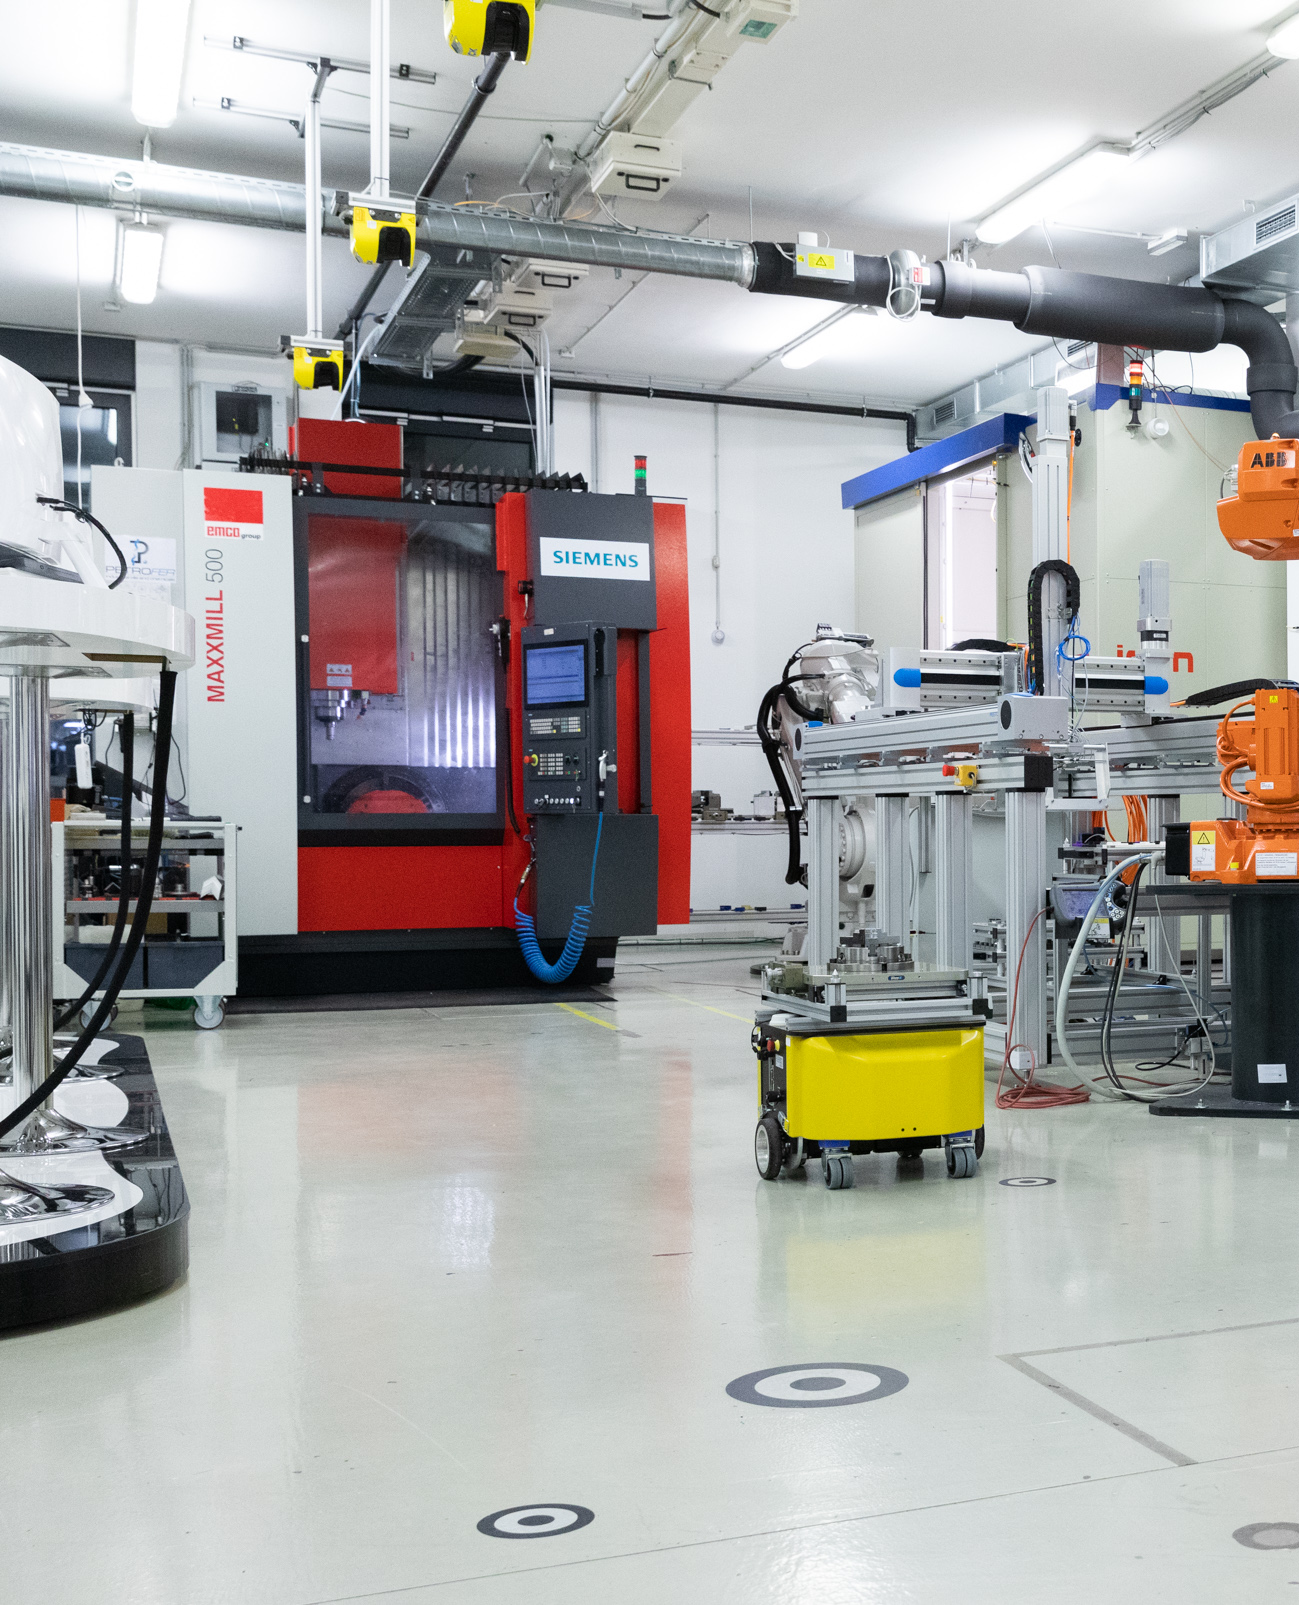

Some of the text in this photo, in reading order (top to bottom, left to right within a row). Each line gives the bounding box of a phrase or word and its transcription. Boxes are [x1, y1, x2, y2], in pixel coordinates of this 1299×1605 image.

[1250, 451, 1287, 469] ABB
[206, 525, 262, 540] emco group
[552, 550, 639, 568] SIEMENS
[204, 548, 225, 702] MAXXMILL 500
